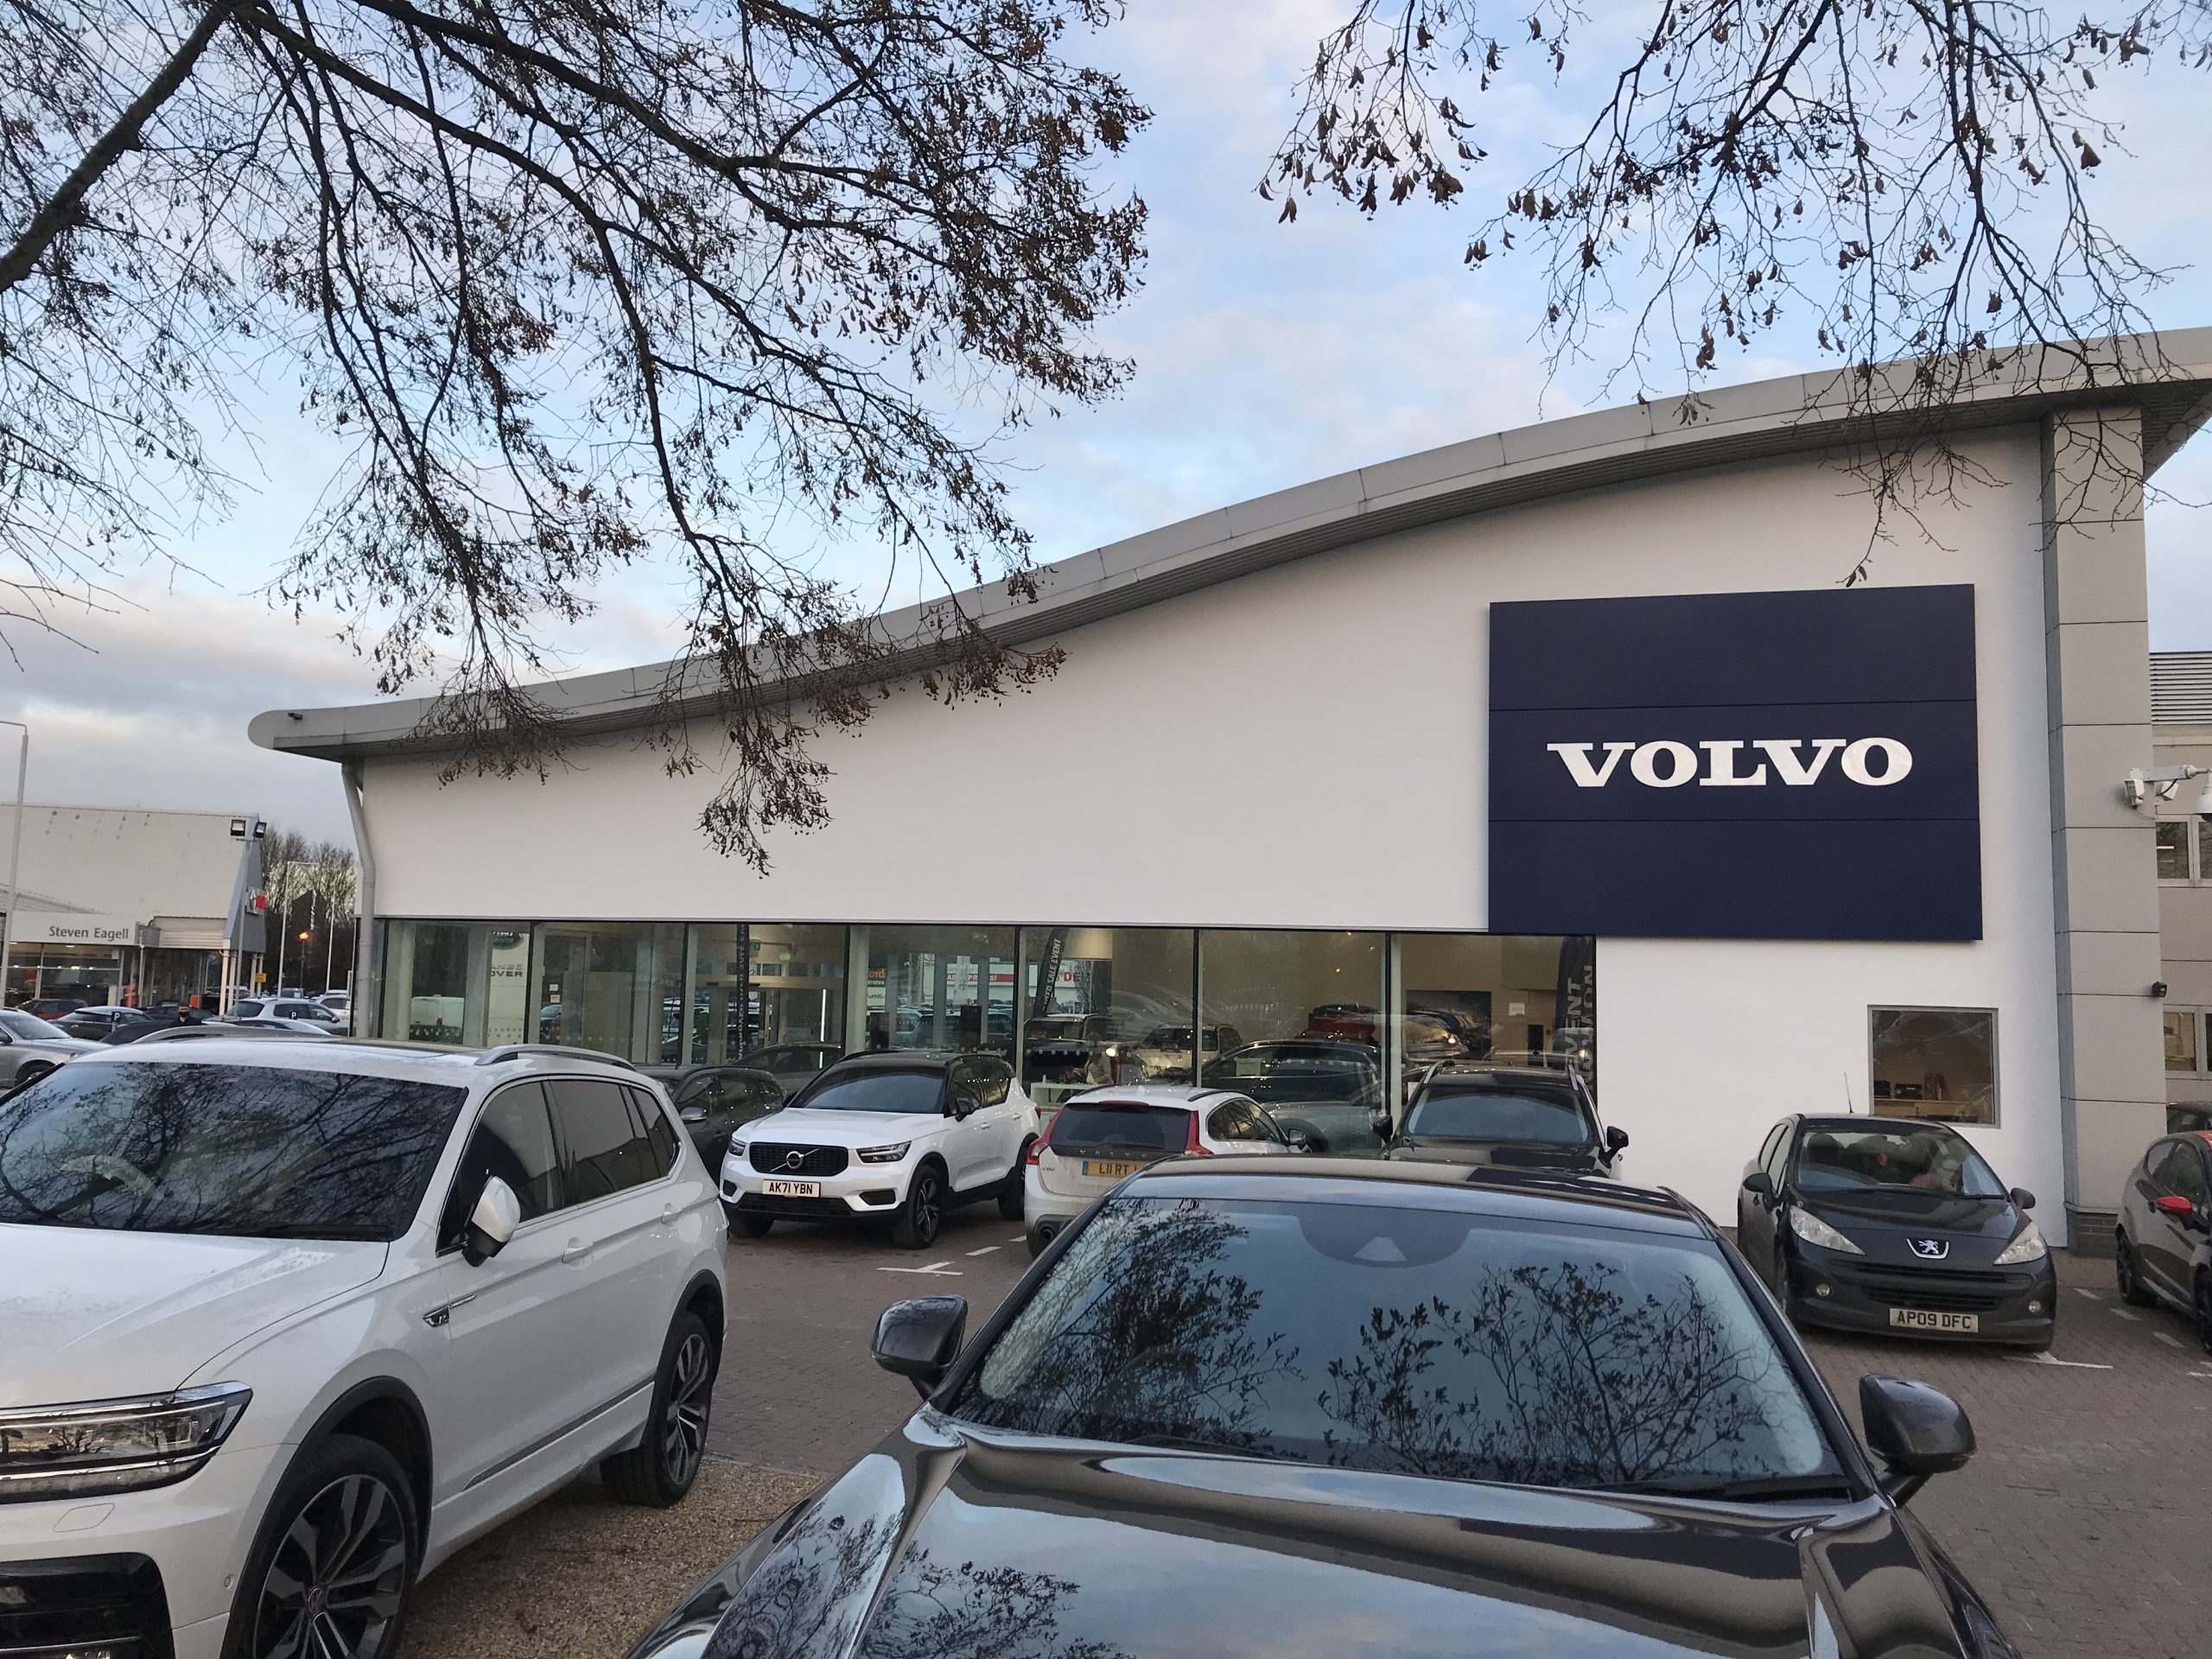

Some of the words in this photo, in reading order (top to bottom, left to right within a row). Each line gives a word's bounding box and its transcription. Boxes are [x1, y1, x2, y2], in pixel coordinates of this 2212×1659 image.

[1547, 737, 1913, 787] VOLVO
[48, 925, 89, 938] Steven
[93, 927, 129, 942] Eagell
[1051, 938, 1062, 964] EVENT
[1046, 965, 1057, 984] SALE
[114, 1012, 120, 1021] P
[291, 1011, 297, 1020] P
[769, 1181, 791, 1193] AK71
[793, 1183, 813, 1195] YBN
[1897, 1310, 1937, 1326] AP09
[1942, 1314, 1972, 1330] DFC
